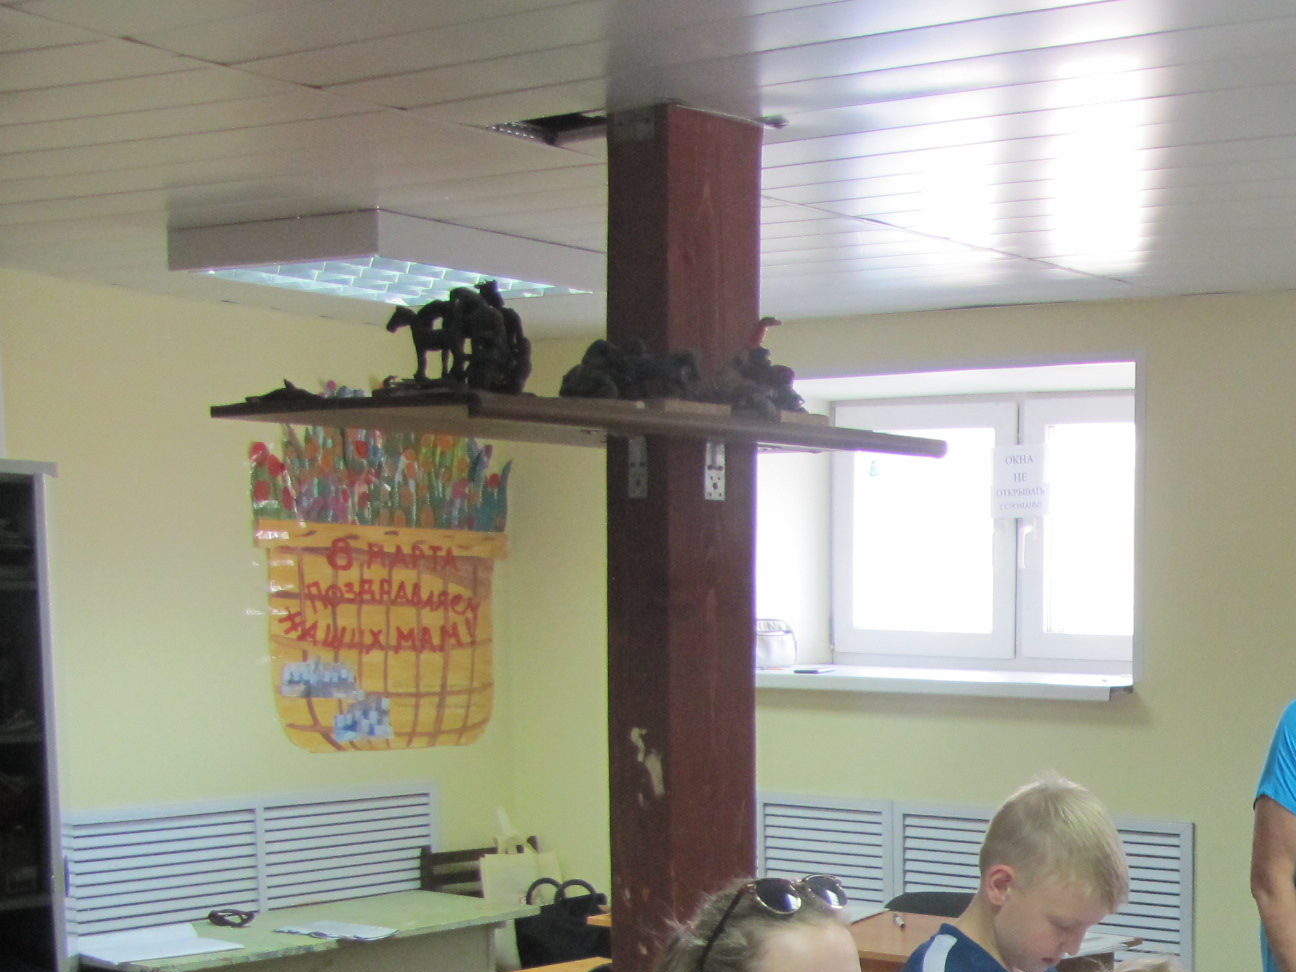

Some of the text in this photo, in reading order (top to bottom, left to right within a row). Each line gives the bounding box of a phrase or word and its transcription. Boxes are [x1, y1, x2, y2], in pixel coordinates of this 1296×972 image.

[1005, 454, 1034, 465] ОКНА
[1013, 472, 1028, 482] НЕ
[996, 487, 1045, 497] ОТКРЫВАТЬ
[326, 537, 459, 572] 8 МАРТА
